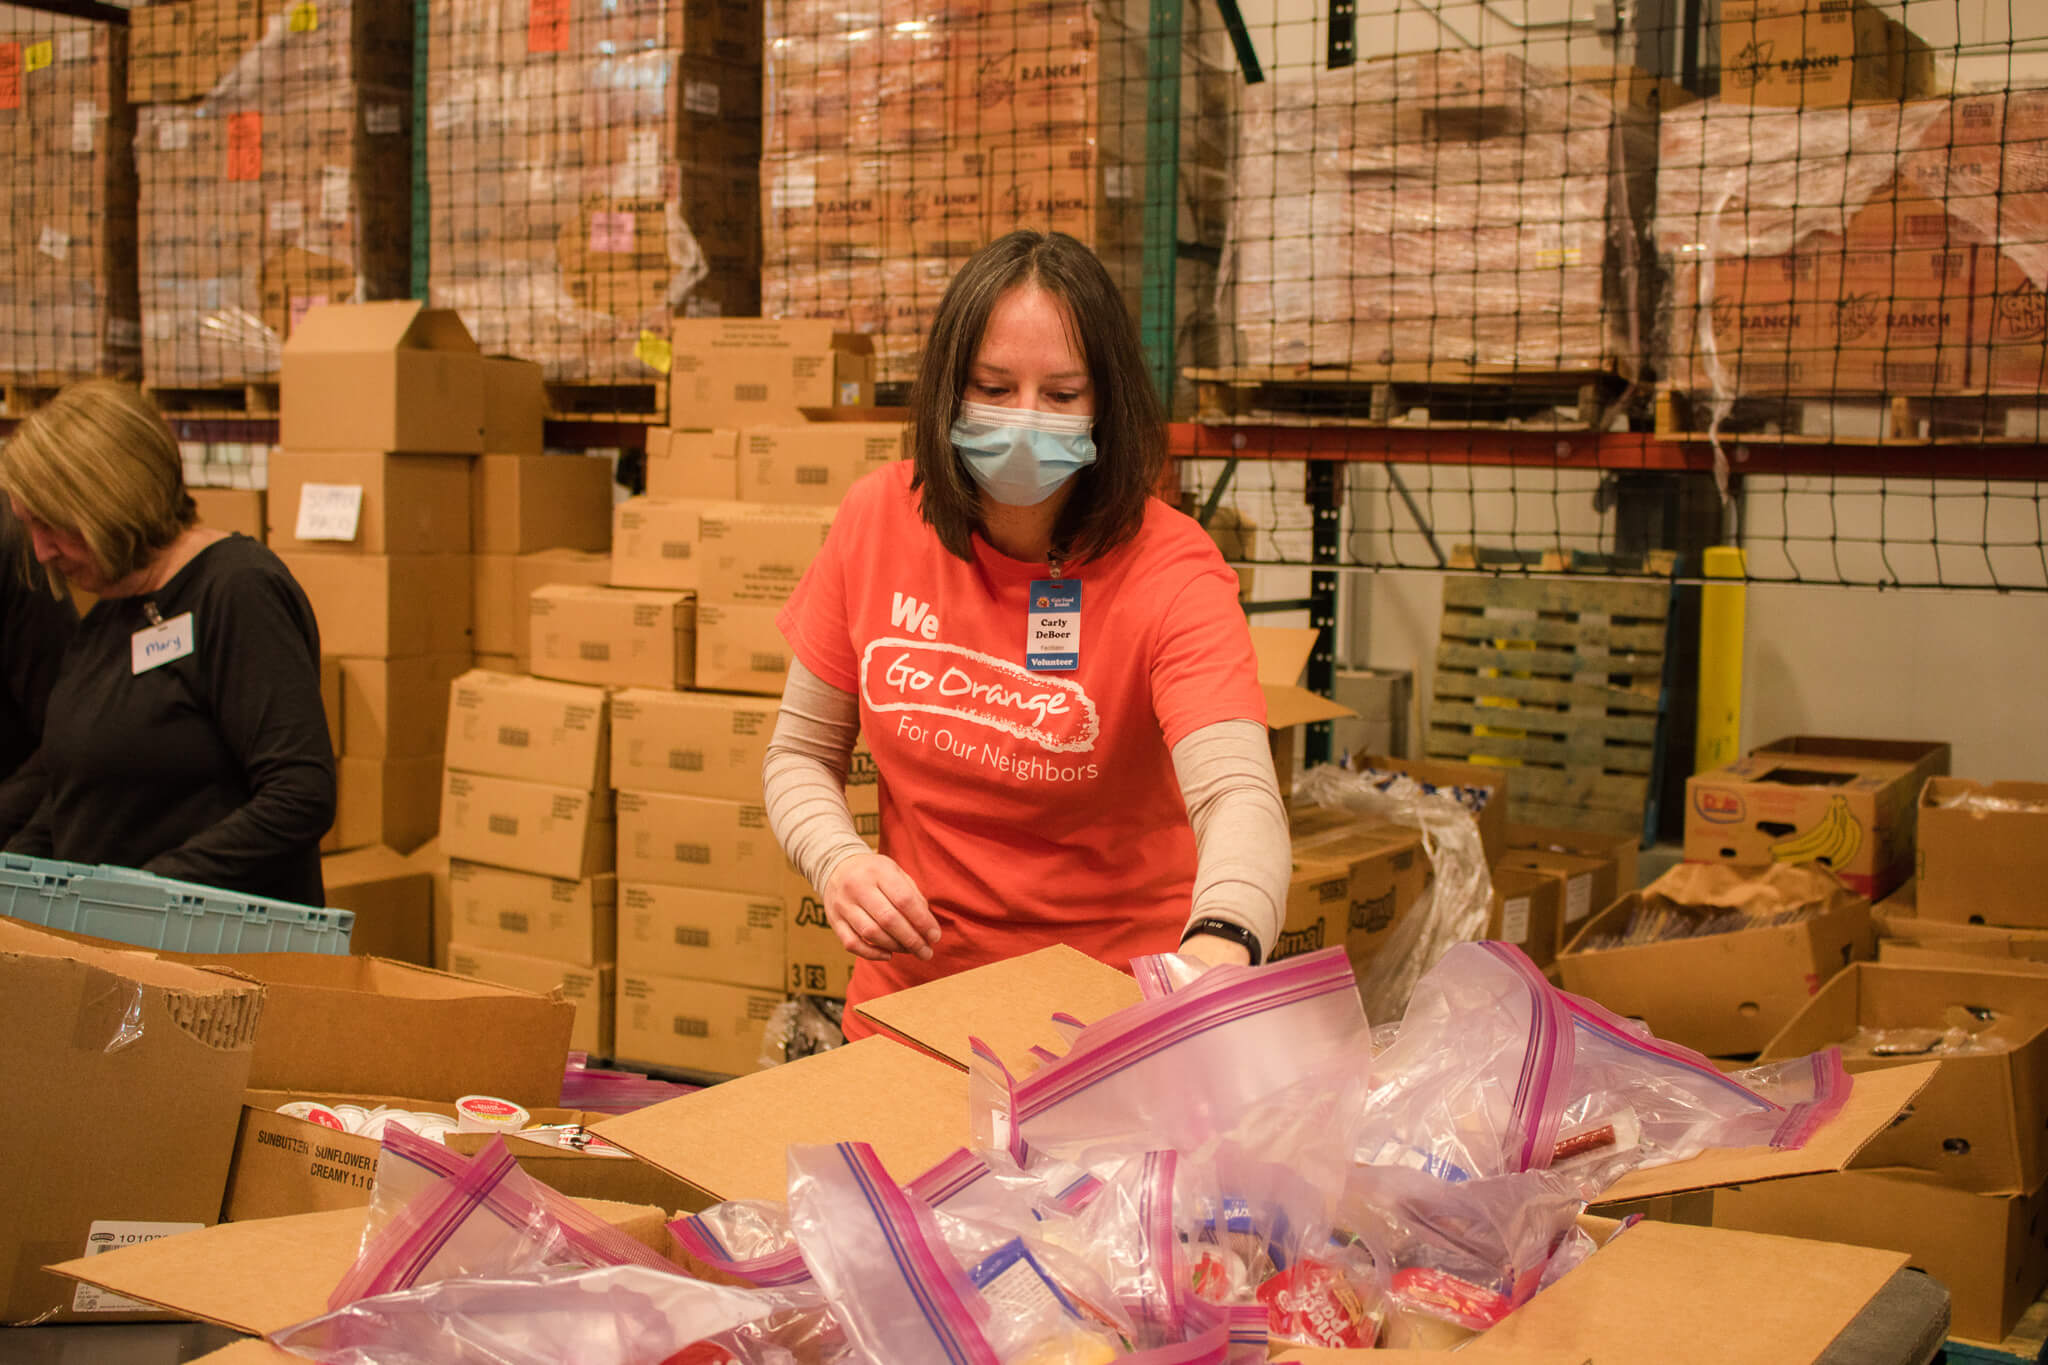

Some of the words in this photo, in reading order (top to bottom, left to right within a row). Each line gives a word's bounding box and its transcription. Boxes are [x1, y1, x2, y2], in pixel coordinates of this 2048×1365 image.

[891, 592, 939, 640] We
[1041, 618, 1067, 628] Carly
[1036, 631, 1071, 639] DeBoer
[1031, 658, 1073, 666] Volunteer
[886, 653, 934, 694] Go
[938, 667, 1070, 727] Orange
[897, 715, 929, 743] For
[934, 729, 977, 760] Our
[981, 743, 1099, 782] Neighbors
[258, 1130, 309, 1155] SUNBUTTER
[315, 1145, 371, 1171] SUNFLOWER
[310, 1162, 350, 1185] CREAMY
[351, 1174, 365, 1189] 1.1
[120, 1234, 168, 1244] 1010
